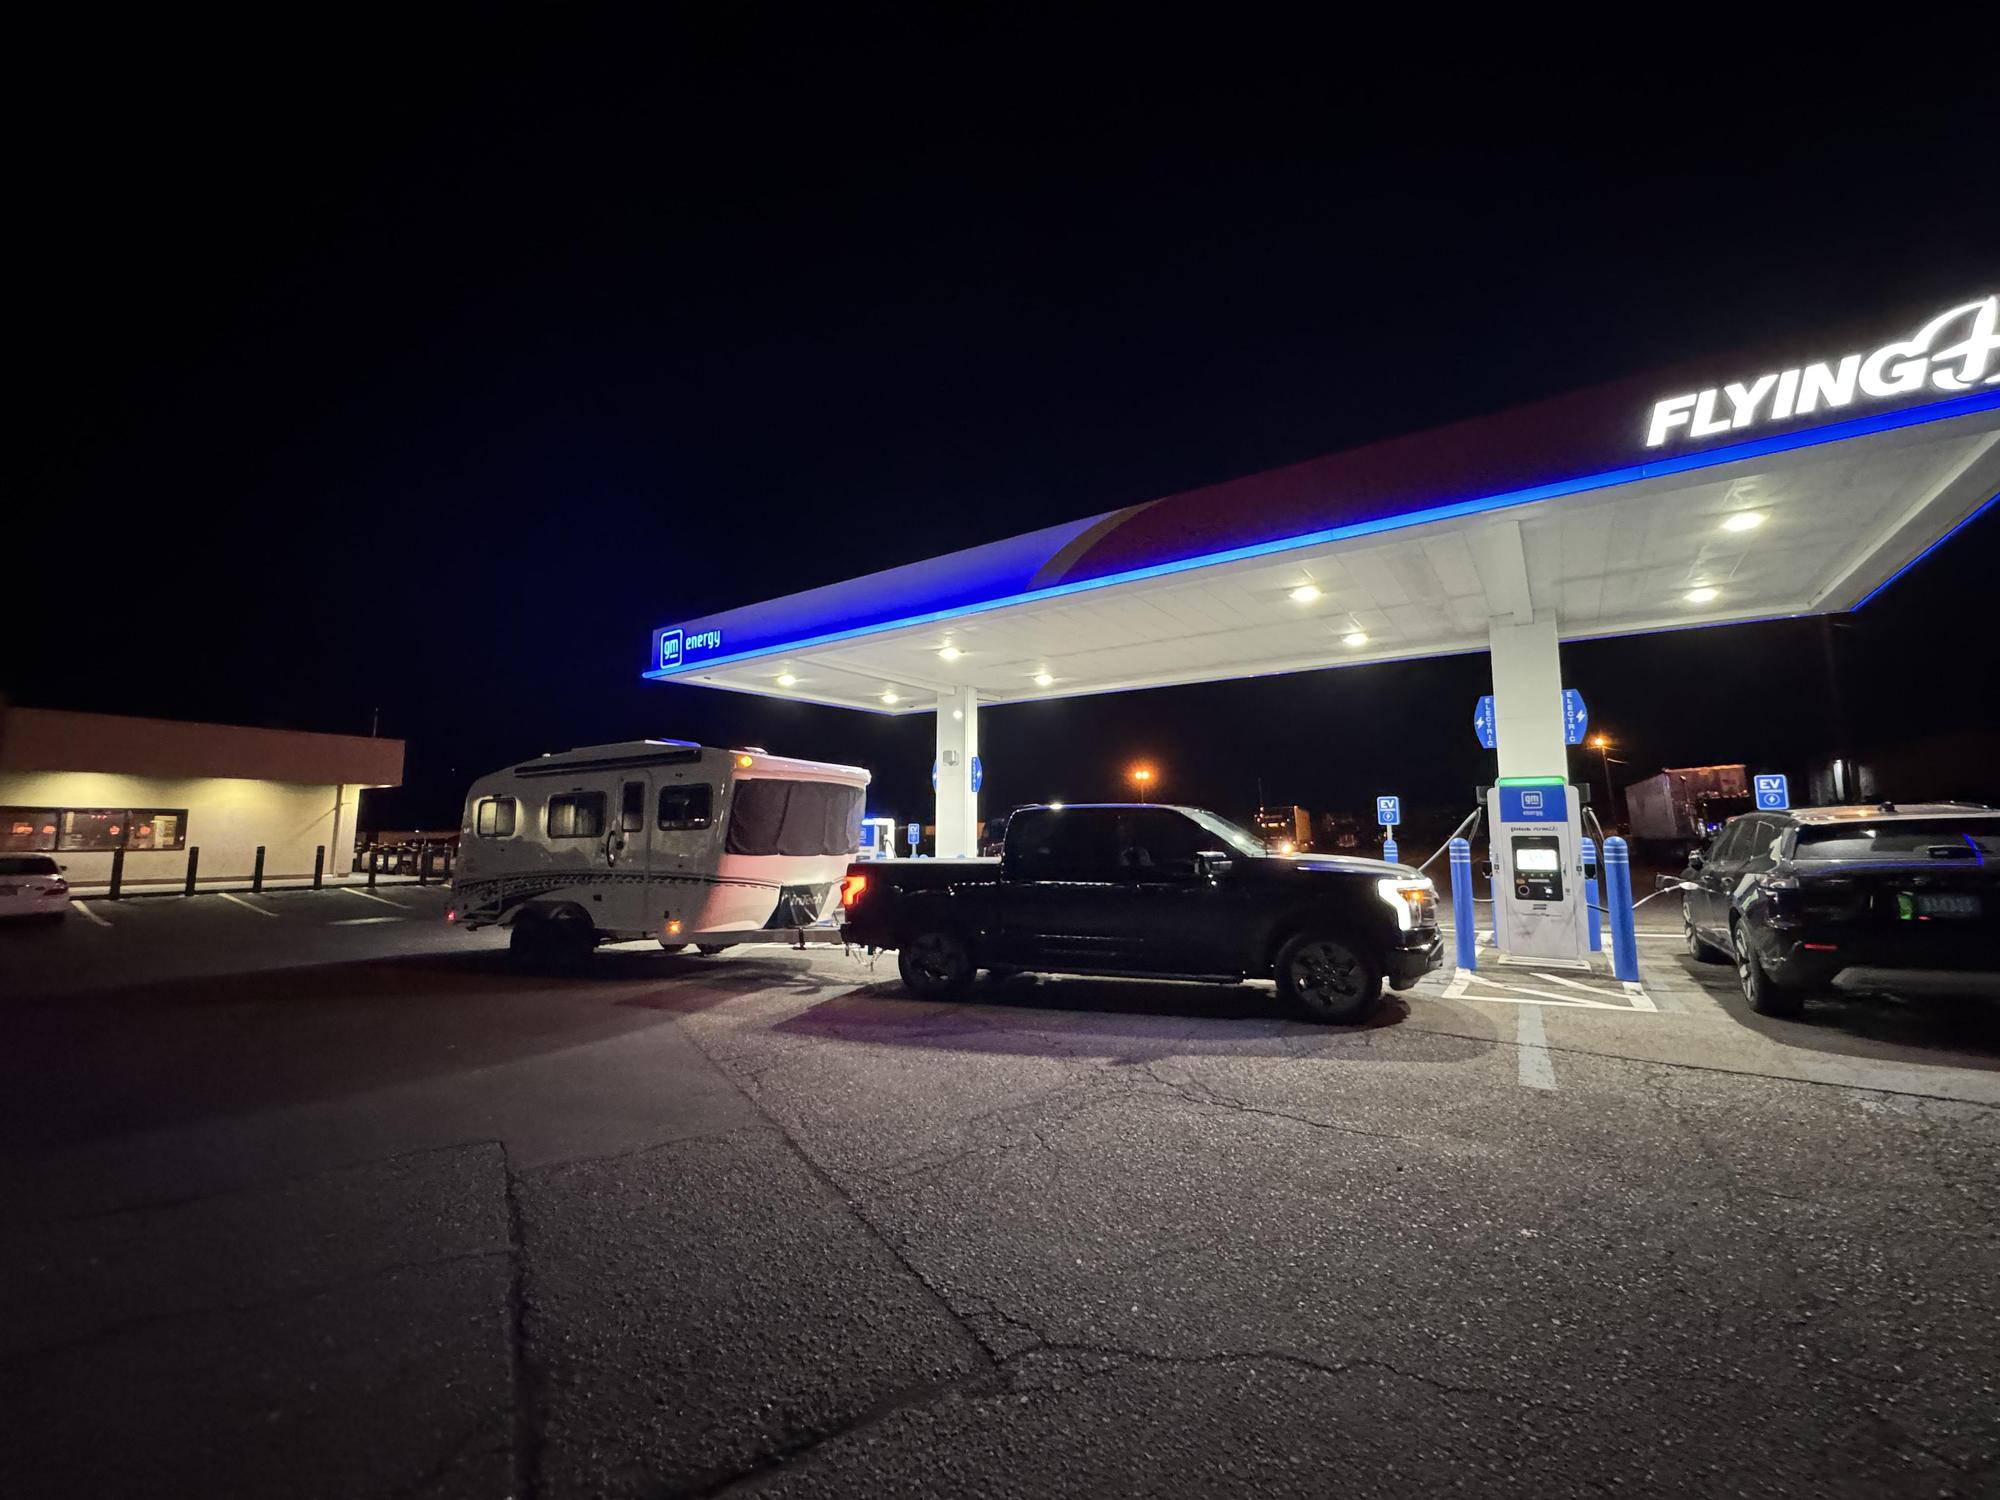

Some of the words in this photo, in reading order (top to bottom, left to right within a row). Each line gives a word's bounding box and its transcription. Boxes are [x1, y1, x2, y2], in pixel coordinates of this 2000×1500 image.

[1646, 341, 1929, 448] FLYING
[664, 638, 679, 660] gm
[685, 630, 721, 650] energy
[1484, 697, 1494, 747] ELECTRIC
[1566, 691, 1577, 743] ELECTRIC
[1759, 778, 1781, 789] EV
[1380, 800, 1394, 808] EV
[1524, 795, 1539, 805] gm
